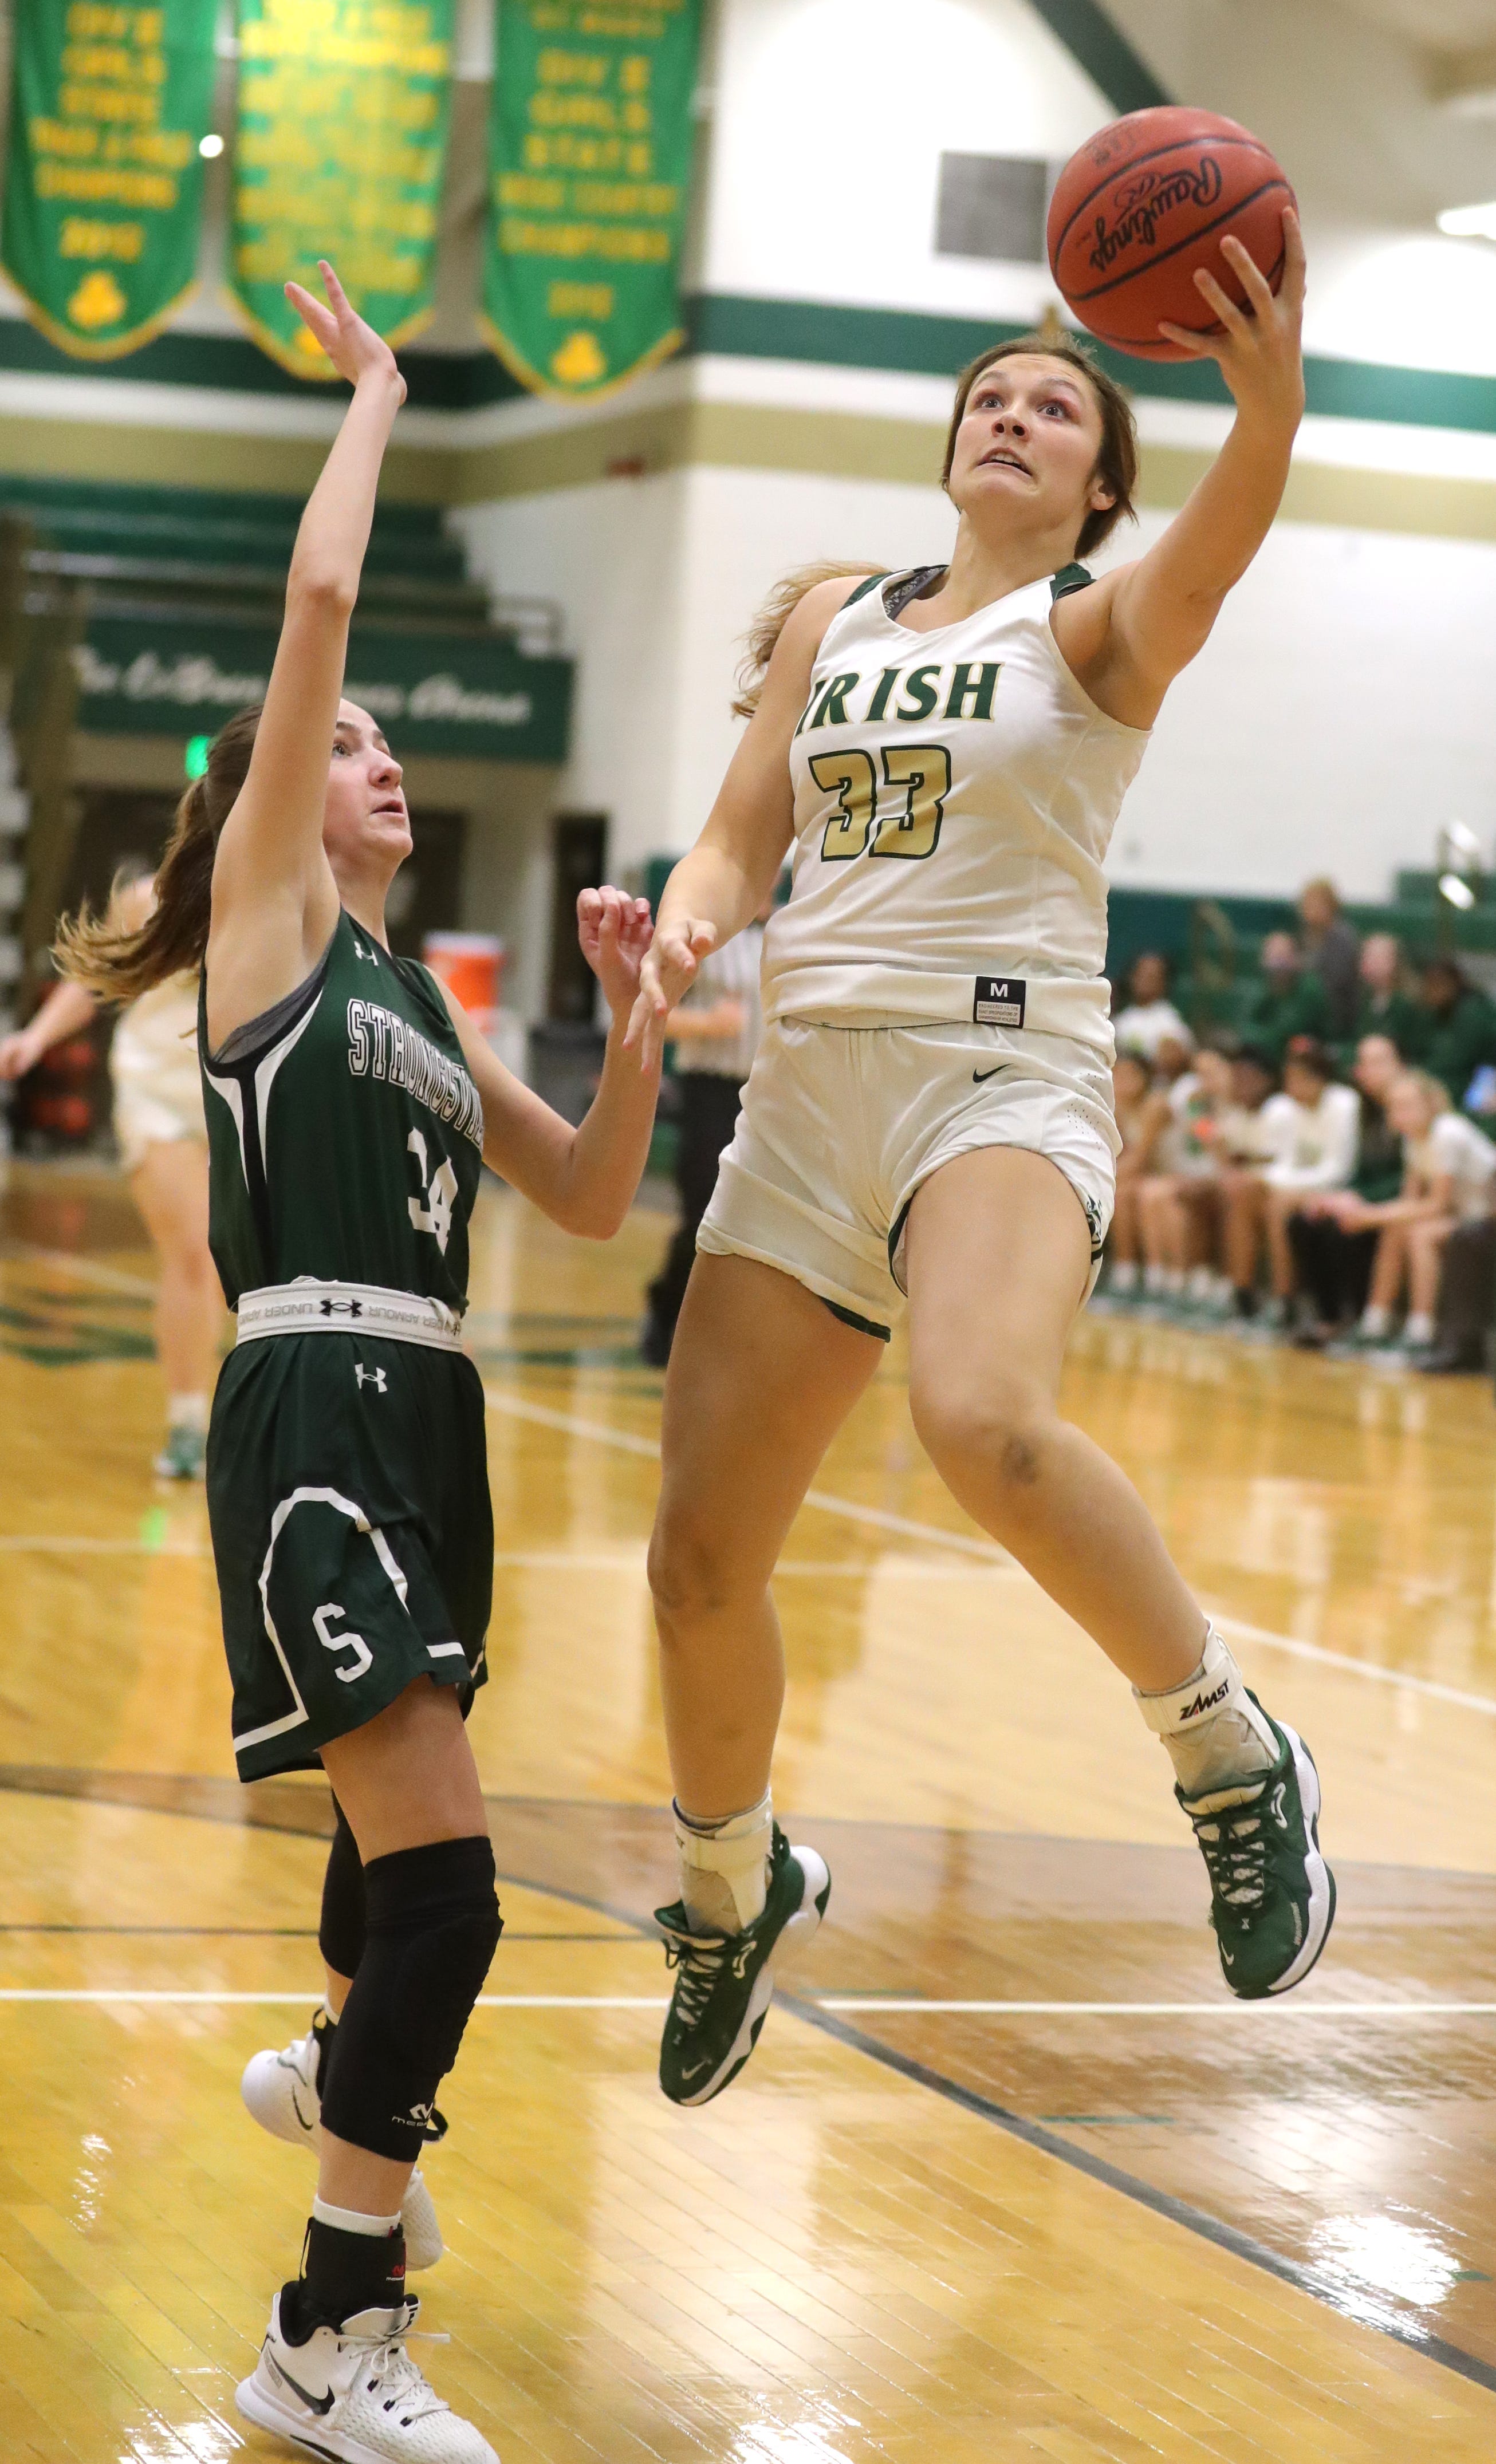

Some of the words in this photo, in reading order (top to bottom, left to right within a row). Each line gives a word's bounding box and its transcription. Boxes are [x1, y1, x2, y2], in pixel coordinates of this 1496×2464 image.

[1089, 156, 1222, 273] Rawlings
[794, 661, 1005, 739] IRISH
[808, 744, 952, 862] 33
[990, 983, 1008, 997] M
[265, 1303, 313, 1318] UNDER
[312, 1603, 373, 1683] S
[1180, 1679, 1229, 1721] ZAMST
